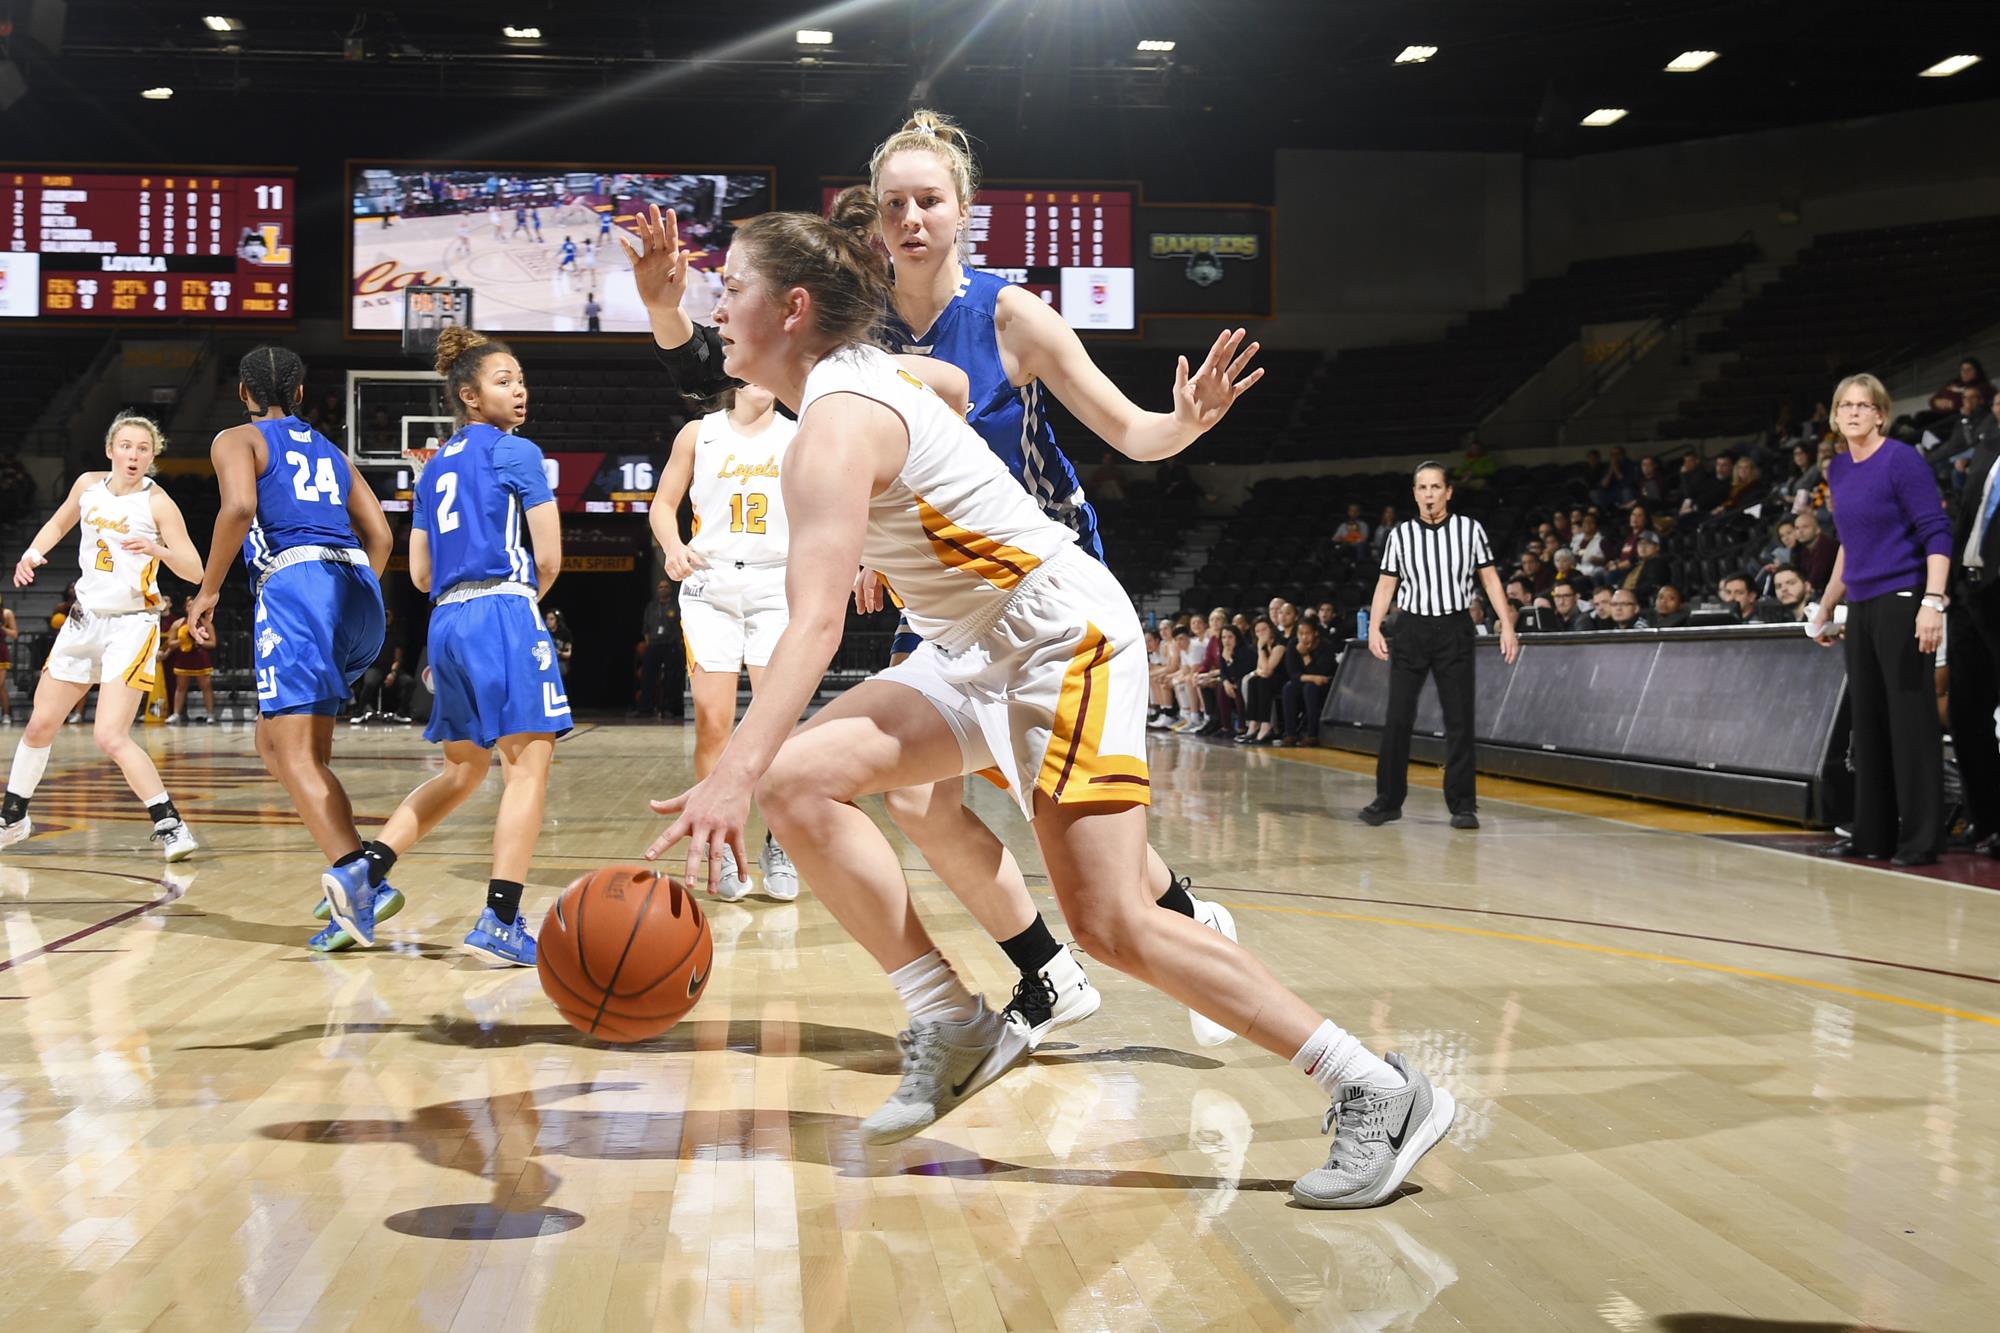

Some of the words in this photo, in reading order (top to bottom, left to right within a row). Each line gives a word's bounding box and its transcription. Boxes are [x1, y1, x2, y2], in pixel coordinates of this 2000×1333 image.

[139, 191, 151, 204] 2
[165, 192, 174, 204] 1
[211, 193, 220, 205] 1
[254, 185, 283, 210] 11
[163, 204, 175, 217] 2
[188, 205, 197, 217] 1
[1071, 206, 1080, 218] 1
[1094, 207, 1103, 219] 1
[139, 216, 151, 229] 5
[163, 229, 174, 242] 2
[187, 230, 197, 243] 1
[211, 231, 220, 243] 1
[1025, 230, 1035, 243] 2
[1049, 231, 1058, 242] 1
[1071, 231, 1080, 243] 1
[1025, 242, 1036, 255] 2
[1071, 244, 1080, 256] 1
[1025, 254, 1036, 267] 2
[1071, 255, 1080, 267] 1
[277, 283, 289, 295] 4
[153, 296, 167, 311] 4
[277, 299, 289, 311] 2
[619, 462, 654, 491] 16
[717, 454, 779, 485] Loyola
[285, 450, 342, 505] 24
[435, 471, 460, 535] 2
[729, 493, 769, 535] 12
[94, 538, 114, 573] 2
